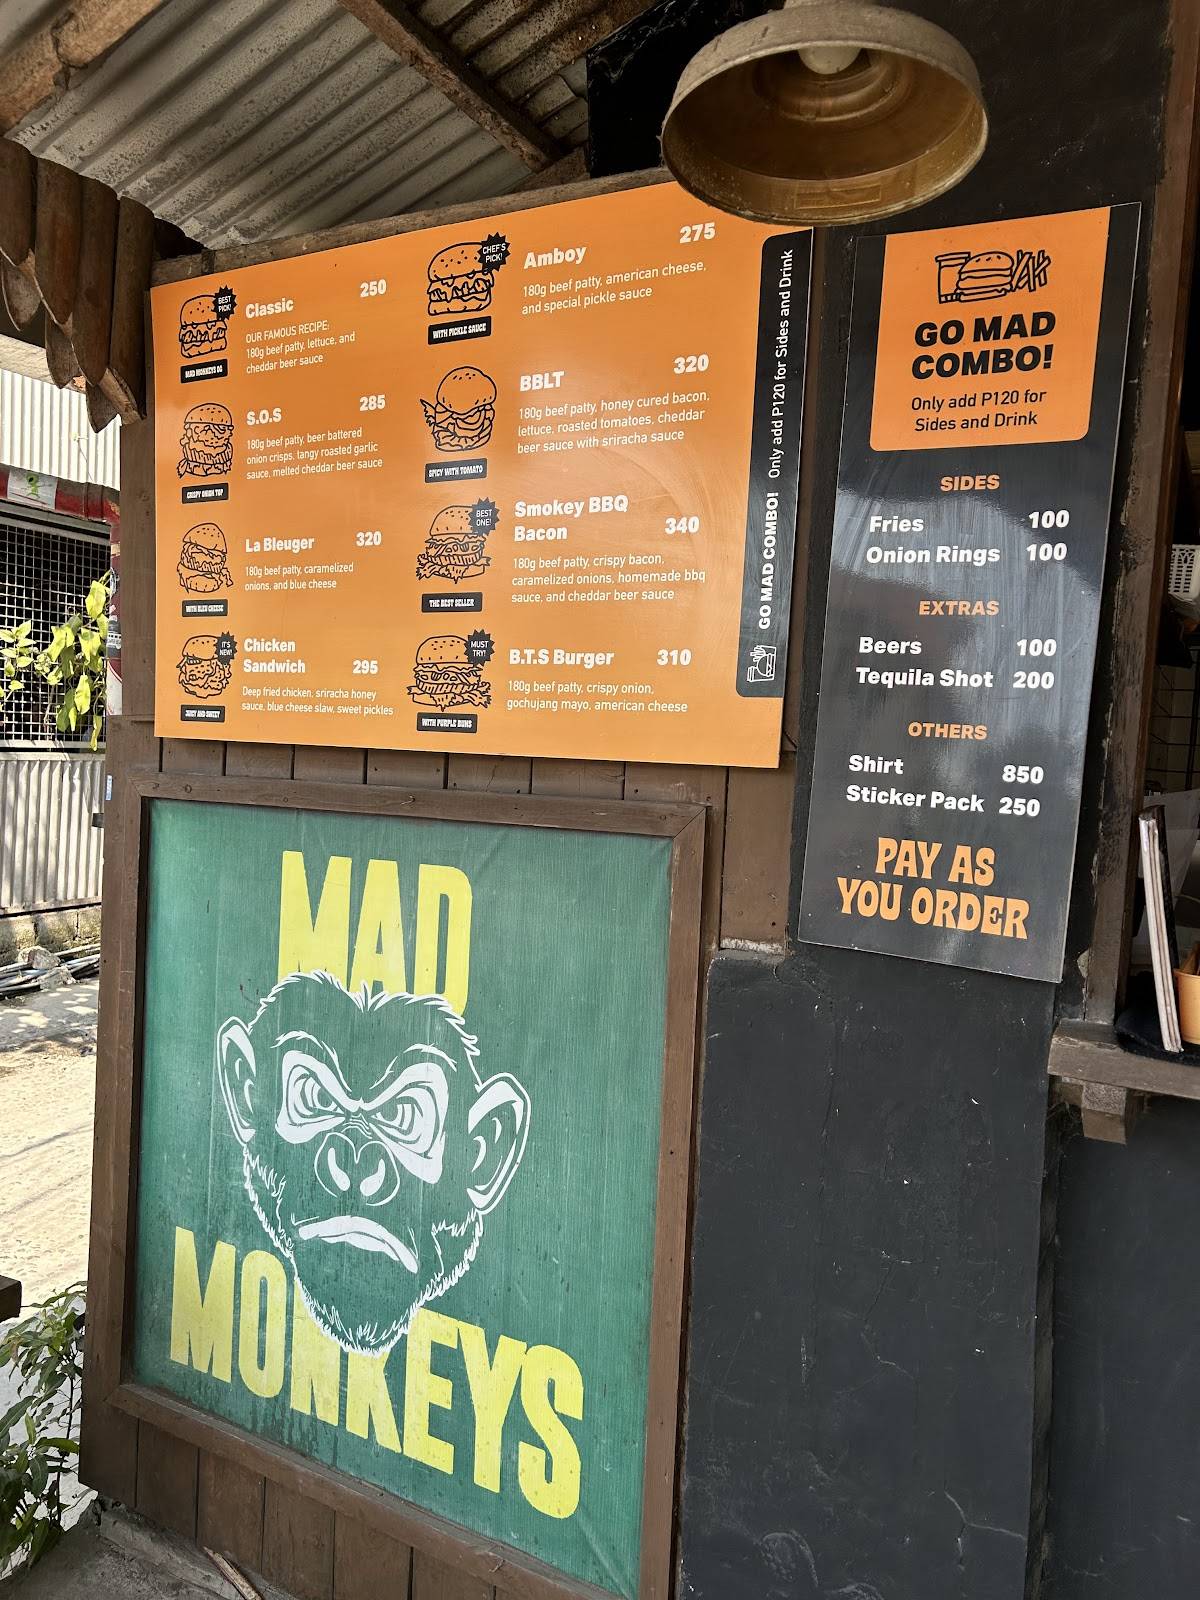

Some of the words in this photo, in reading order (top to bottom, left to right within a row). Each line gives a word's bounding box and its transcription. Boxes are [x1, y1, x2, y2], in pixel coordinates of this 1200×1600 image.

[483, 243, 506, 254] CHEF'S
[523, 247, 586, 269] Amboy
[679, 222, 715, 243] 275
[486, 253, 502, 263] PICK!
[779, 250, 793, 286] Drink
[523, 283, 546, 297] 180g
[549, 278, 572, 293] beef
[575, 276, 602, 292] patty,
[605, 268, 658, 284] american
[661, 261, 705, 276] cheese,
[218, 296, 231, 304] BEST
[218, 304, 231, 312] PICK!
[245, 297, 293, 318] Classic
[360, 279, 386, 297] 250
[521, 301, 541, 315] and
[543, 294, 581, 313] special
[583, 290, 616, 308] pickle
[618, 287, 652, 300] sauce
[779, 291, 790, 316] and
[245, 331, 262, 343] OUR
[263, 325, 296, 340] FAMOUS
[298, 319, 329, 334] RECIPE:
[432, 328, 448, 338] WITH
[448, 325, 467, 336] PICKLE
[467, 322, 486, 333] SAUCE
[776, 320, 789, 356] Sides
[914, 319, 964, 347] GO
[972, 311, 1056, 342] MAD
[246, 347, 264, 359] 180g
[265, 343, 283, 355] beef
[284, 340, 305, 355] patty,
[307, 336, 337, 348] lettuce,
[338, 330, 355, 343] and
[246, 360, 278, 374] cheddar
[279, 358, 297, 368] beer
[299, 354, 323, 365] sauce
[519, 371, 564, 391] BBLT
[673, 354, 709, 374] 320
[774, 361, 786, 380] for
[911, 343, 1053, 379] COMBO!
[246, 407, 281, 425] S.O.S
[359, 394, 385, 411] 285
[519, 406, 542, 420] 180g
[545, 403, 568, 416] beef
[570, 401, 597, 416] patty,
[600, 399, 634, 411] honey
[636, 392, 669, 407] cured
[672, 391, 709, 404] bacon,
[772, 383, 786, 416] P120
[911, 395, 944, 412] Only
[948, 393, 976, 408] add
[981, 390, 1019, 406] P120
[1024, 389, 1046, 403] for
[518, 425, 554, 436] lettuce,
[557, 418, 597, 432] roasted
[600, 415, 654, 428] tomatoes,
[657, 408, 705, 423] cheddar
[771, 419, 783, 445] add
[914, 417, 956, 431] Sides
[960, 413, 989, 429] and
[994, 411, 1037, 427] Drink
[247, 439, 264, 451] 180g
[266, 436, 283, 447] beef
[284, 434, 304, 448] patty,
[306, 433, 326, 443] beer
[327, 427, 362, 440] battered
[517, 443, 540, 453] beer
[543, 440, 573, 451] sauce
[576, 436, 599, 448] with
[601, 431, 647, 446] sriracha
[650, 430, 684, 442] sauce
[246, 453, 267, 464] onion
[269, 451, 294, 463] crisps,
[296, 449, 319, 460] tangy
[320, 443, 352, 456] roasted
[353, 441, 378, 456] garlic
[769, 449, 784, 478] Only
[246, 470, 270, 479] sauce,
[272, 464, 299, 476] melted
[301, 462, 334, 474] cheddar
[336, 460, 355, 470] beer
[357, 458, 382, 469] sauce
[428, 468, 443, 477] SPICY
[444, 467, 459, 476] WITH
[459, 464, 483, 474] TOMATO
[940, 474, 999, 491] SIDES
[476, 509, 492, 517] BEST
[514, 499, 584, 517] Smokey
[588, 494, 628, 512] BBQ
[514, 525, 567, 541] Bacon
[664, 516, 699, 534] 340
[764, 492, 779, 560] COMBO!
[869, 515, 923, 533] Fries
[1028, 509, 1069, 528] 100
[245, 539, 260, 552] La
[263, 537, 314, 553] Bleuger
[356, 531, 381, 546] 320
[866, 546, 930, 563] Onion
[935, 545, 1000, 566] Rings
[1026, 542, 1067, 563] 100
[513, 557, 535, 571] 180g
[538, 556, 561, 568] beef
[563, 555, 589, 570] patty,
[592, 554, 626, 568] crispy
[628, 553, 664, 565] bacon,
[511, 573, 573, 585] caramelized
[576, 572, 614, 584] onions,
[618, 569, 681, 582] homemade
[684, 568, 705, 583] bbq
[761, 563, 774, 601] MAD
[511, 593, 543, 602] sauce,
[545, 590, 565, 602] and
[567, 589, 611, 601] cheddar
[613, 589, 639, 600] beer
[641, 590, 674, 600] sauce
[918, 600, 999, 615] EXTRAS
[759, 605, 771, 630] GO
[243, 638, 295, 652] Chicken
[859, 636, 921, 654] Beers
[1016, 638, 1056, 656] 100
[243, 658, 305, 673] Sandwich
[352, 659, 378, 674] 295
[509, 648, 549, 664] B.T.S
[553, 649, 614, 669] Burger
[657, 648, 691, 665] 310
[508, 680, 530, 694] 180g
[533, 680, 555, 692] beef
[557, 681, 583, 695] patty,
[586, 681, 619, 696] crispy
[621, 682, 654, 694] onion,
[855, 667, 934, 688] Tequila
[939, 669, 993, 687] Shot
[1012, 670, 1054, 689] 200
[908, 722, 987, 740] OTHERS
[848, 754, 903, 774] Shirt
[1002, 764, 1043, 784] 850
[846, 784, 926, 807] Sticker
[930, 791, 984, 812] Pack
[998, 796, 1040, 817] 250
[875, 837, 942, 879] PAY
[947, 845, 995, 886] AS
[837, 876, 903, 920] YOU
[911, 886, 1029, 939] ORDER
[278, 851, 472, 1016] MAD
[170, 1226, 583, 1519] MONKEYS
